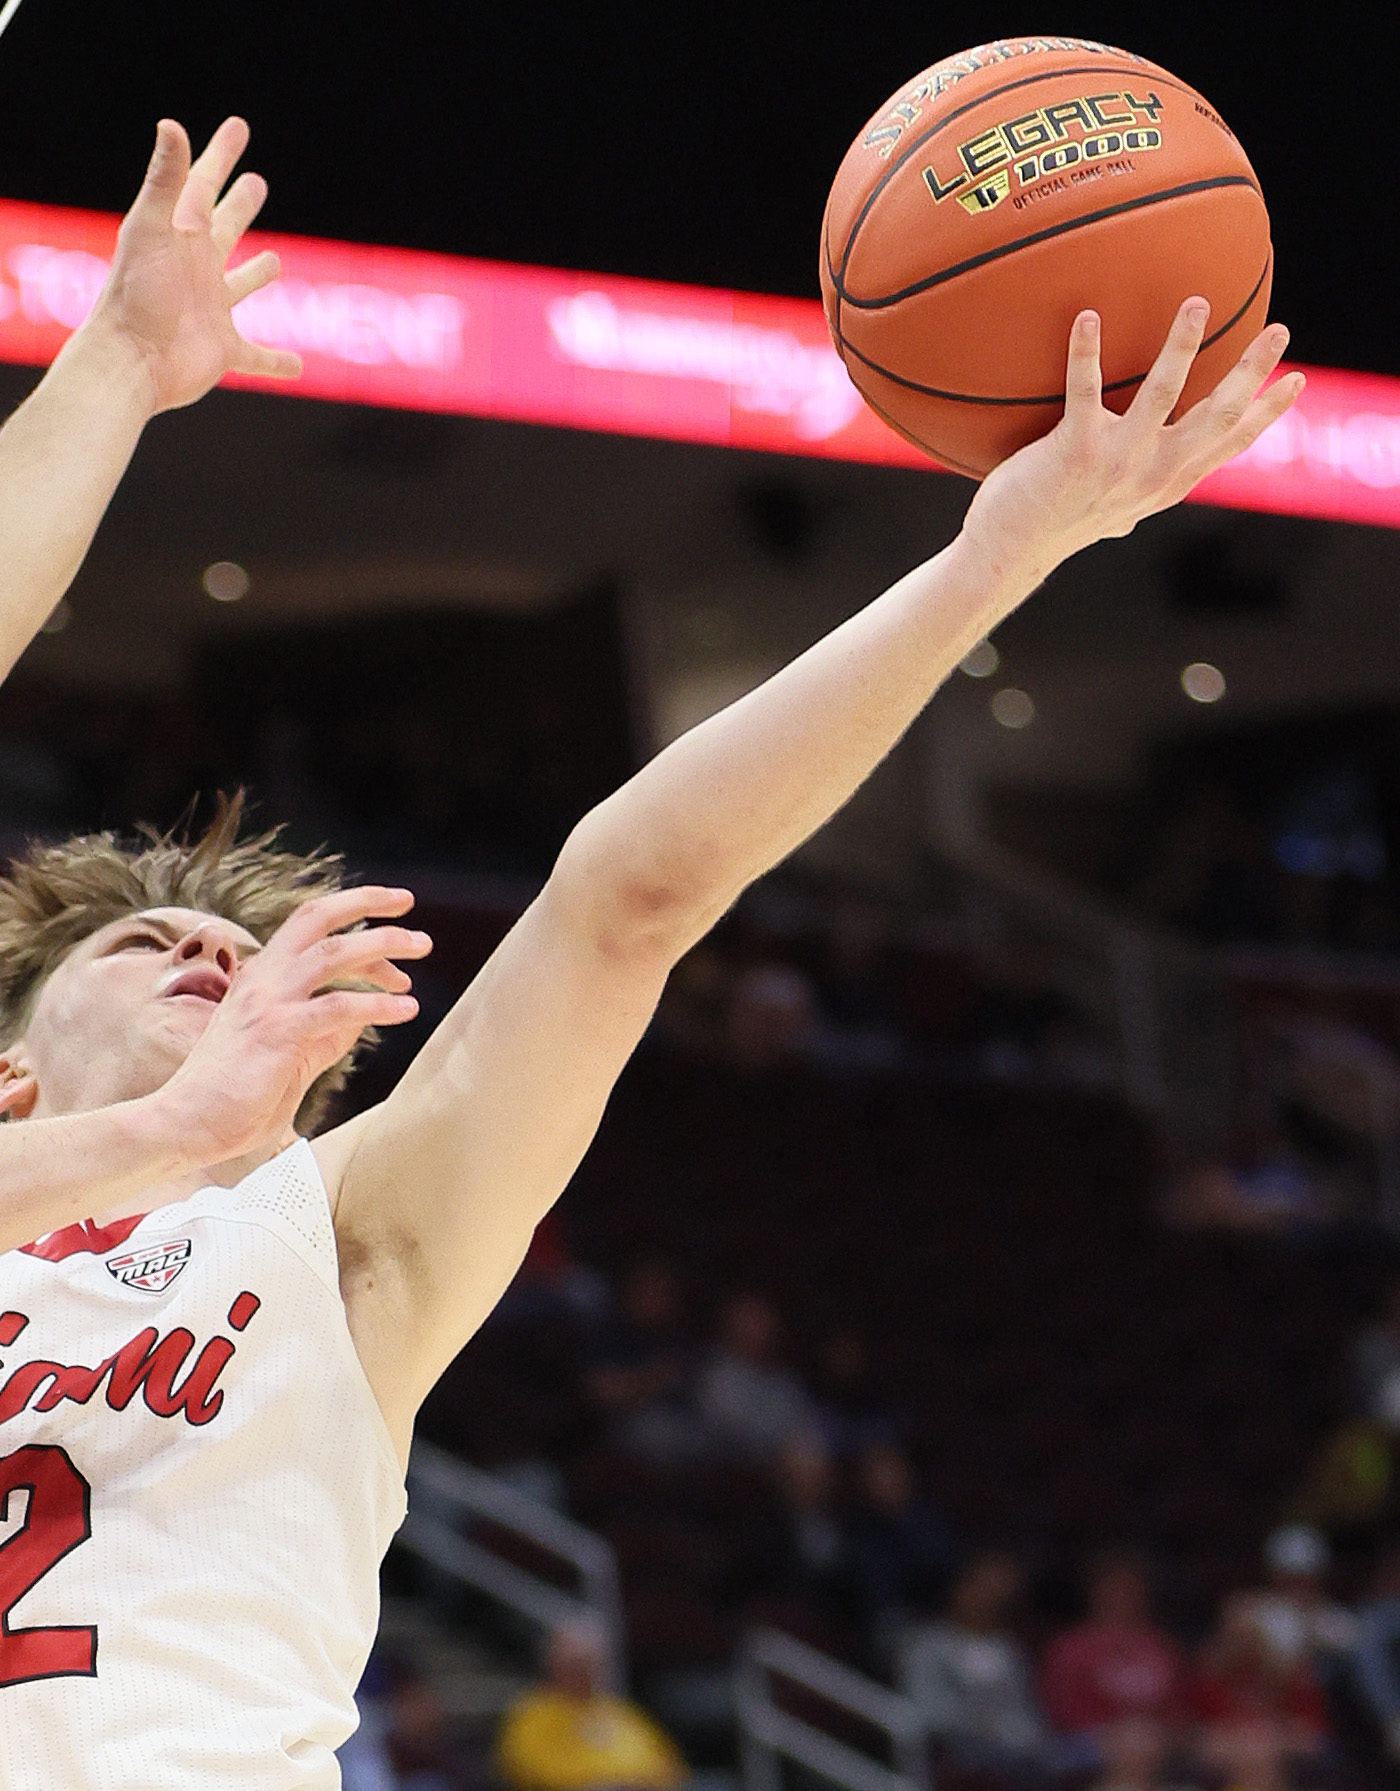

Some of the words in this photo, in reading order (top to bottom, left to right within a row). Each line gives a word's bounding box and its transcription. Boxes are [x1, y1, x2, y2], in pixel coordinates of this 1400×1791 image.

[922, 90, 1164, 204] LEGACY
[1013, 127, 1162, 187] 1000
[1012, 177, 1068, 209] OFFICIAL
[1070, 165, 1104, 187] GAME
[116, 1247, 190, 1282] MAC
